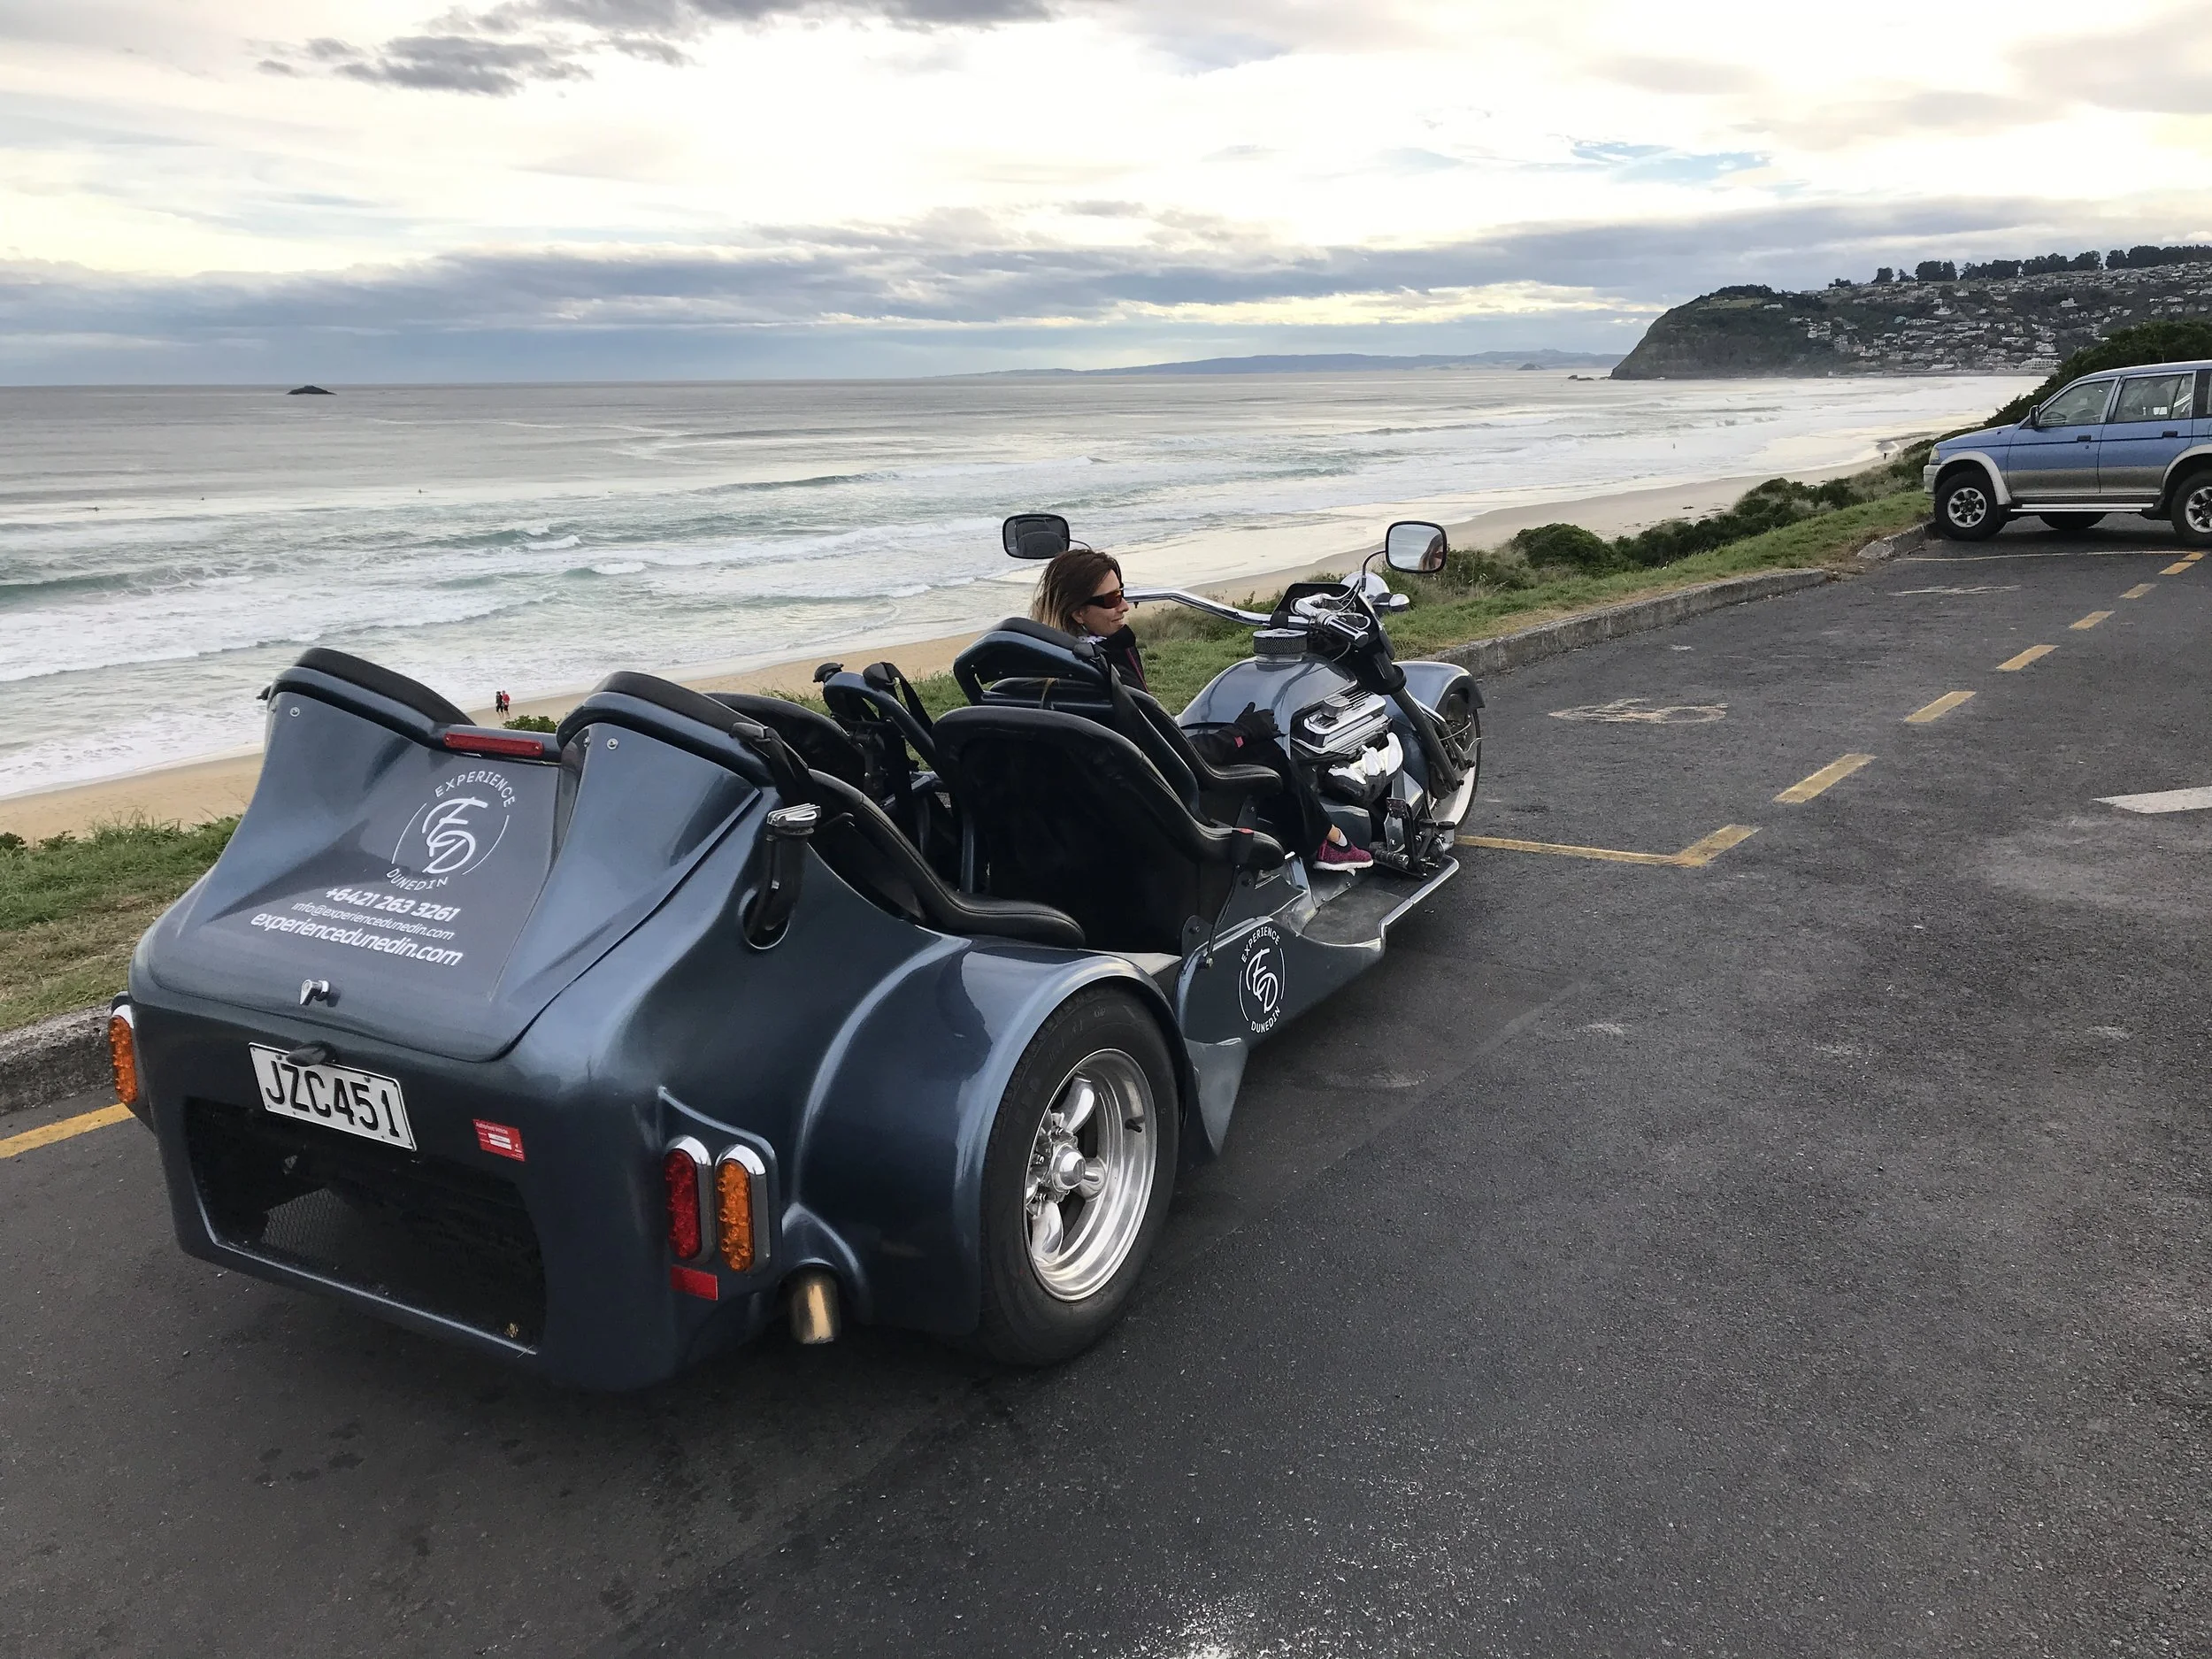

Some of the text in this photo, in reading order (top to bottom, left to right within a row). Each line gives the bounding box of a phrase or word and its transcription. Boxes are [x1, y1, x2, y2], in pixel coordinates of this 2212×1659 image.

[434, 770, 515, 807] EXPERIENCE
[386, 868, 449, 891] DUNEDIN
[291, 902, 455, 941] info@experiencedunedin.com
[326, 887, 461, 922] +6421 263 3261
[250, 913, 464, 966] experiencedunedin.com
[1240, 926, 1280, 963] EXPERIENCE
[1250, 1005, 1280, 1033] DUNEDIN
[265, 1060, 400, 1138] JZC451
